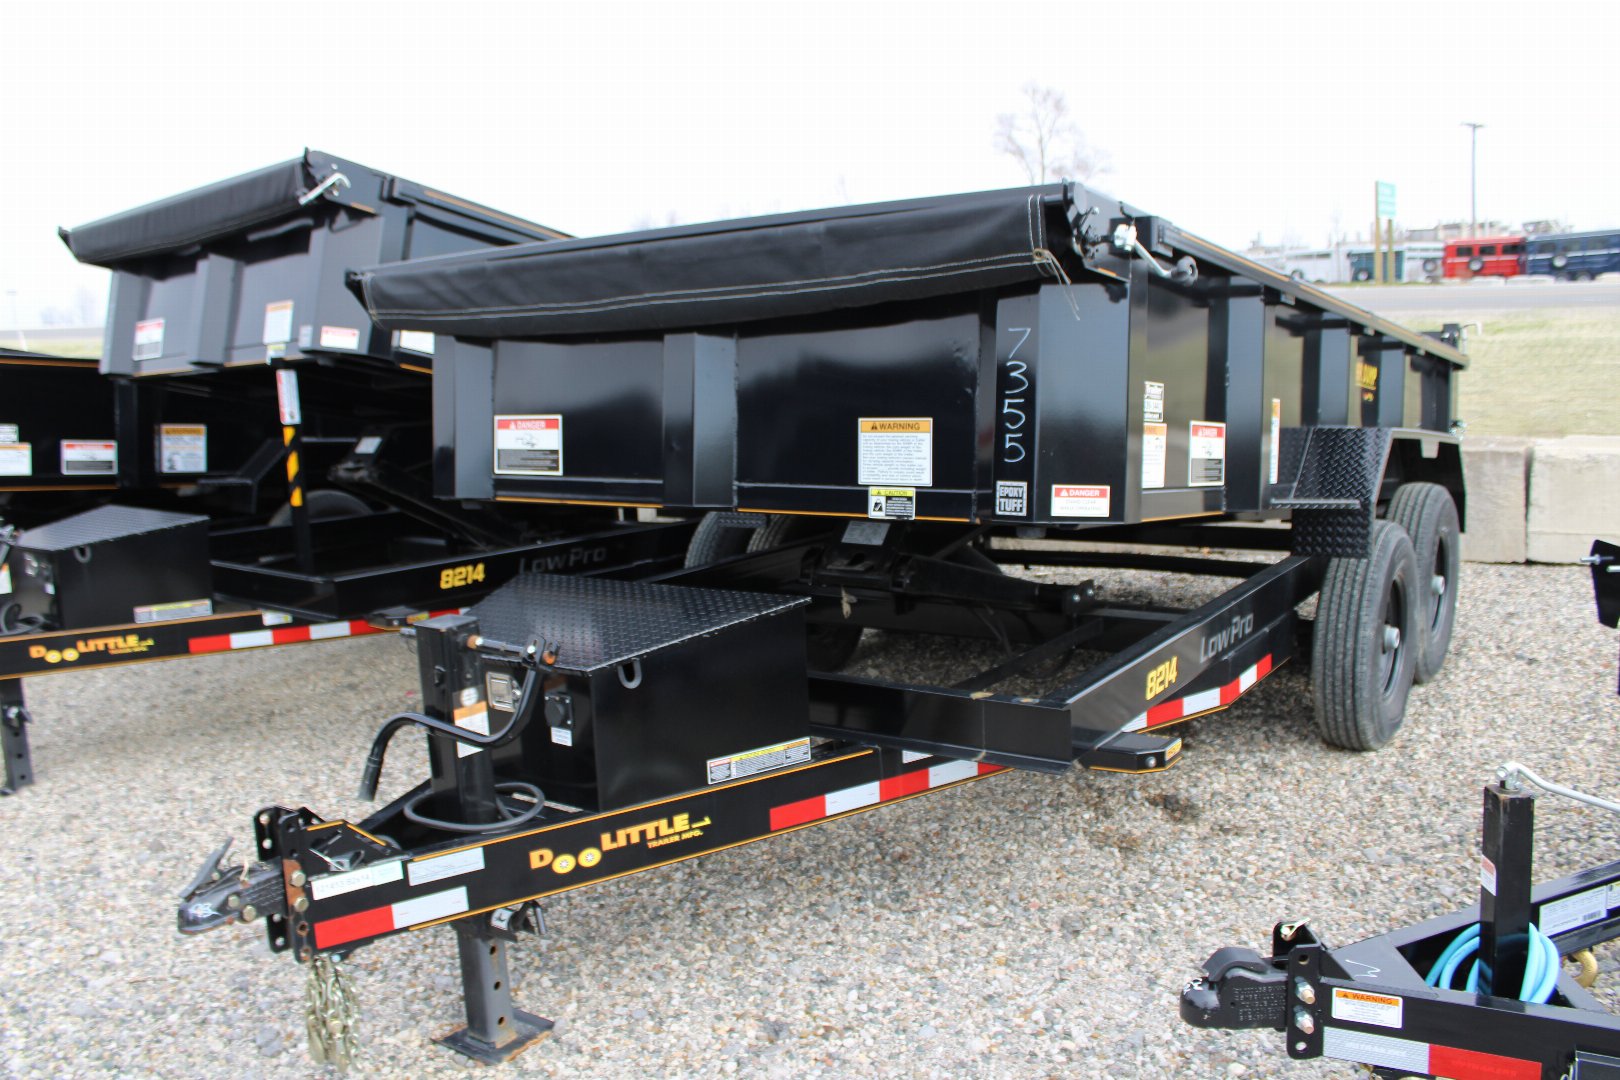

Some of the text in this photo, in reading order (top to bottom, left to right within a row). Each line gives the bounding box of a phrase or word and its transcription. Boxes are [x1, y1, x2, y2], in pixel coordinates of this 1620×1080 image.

[1002, 327, 1032, 463] 7355
[879, 422, 921, 431] WARNING
[999, 486, 1024, 498] EPOXY
[1069, 489, 1100, 497] DANGER
[1000, 498, 1023, 512] TUFF
[439, 562, 486, 590] 8214
[1145, 655, 1179, 701] 8214
[647, 829, 704, 849] TRAILER MFG.
[1352, 993, 1393, 1005] WARNING
